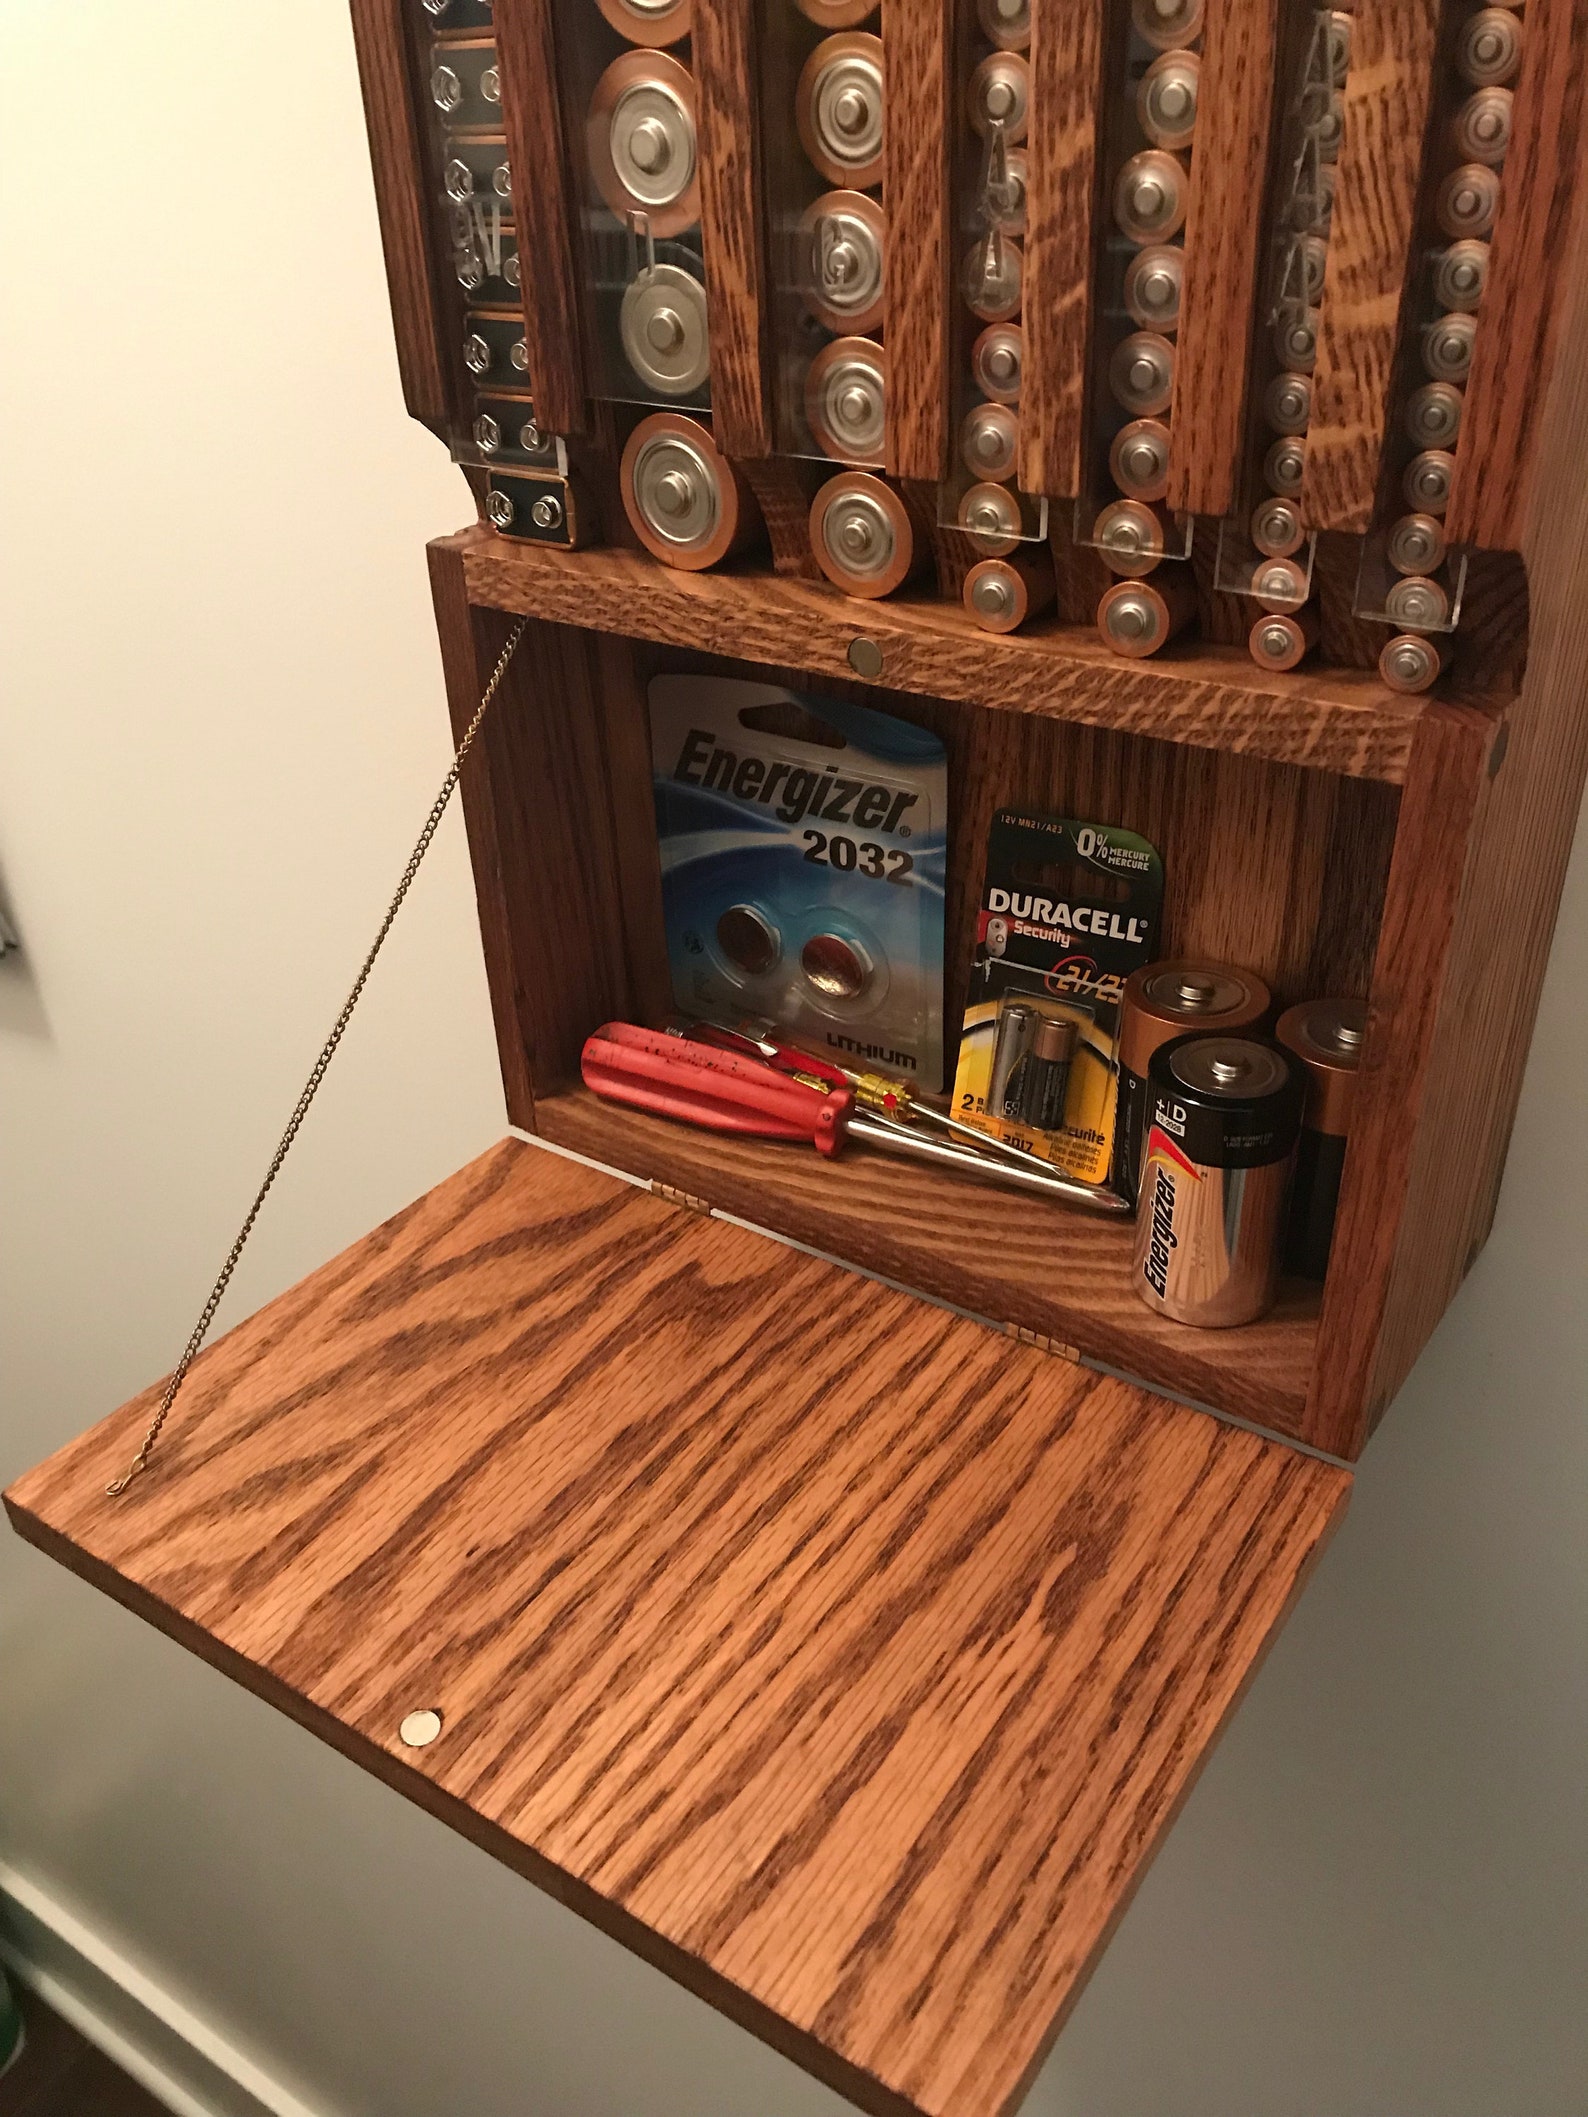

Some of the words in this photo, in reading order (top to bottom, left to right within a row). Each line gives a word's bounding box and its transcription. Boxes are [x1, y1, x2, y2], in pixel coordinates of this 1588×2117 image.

[673, 728, 919, 833] Energizer
[803, 829, 914, 887] 2032
[1077, 828, 1109, 859] 0%
[1109, 846, 1151, 862] MERCURY
[1107, 856, 1150, 871] MERCURE
[988, 887, 1144, 943] DURACELL
[1013, 920, 1071, 949] Security
[826, 1031, 917, 1070] LITHIUM
[961, 1093, 975, 1111] 2
[1143, 1165, 1178, 1300] Energizer
